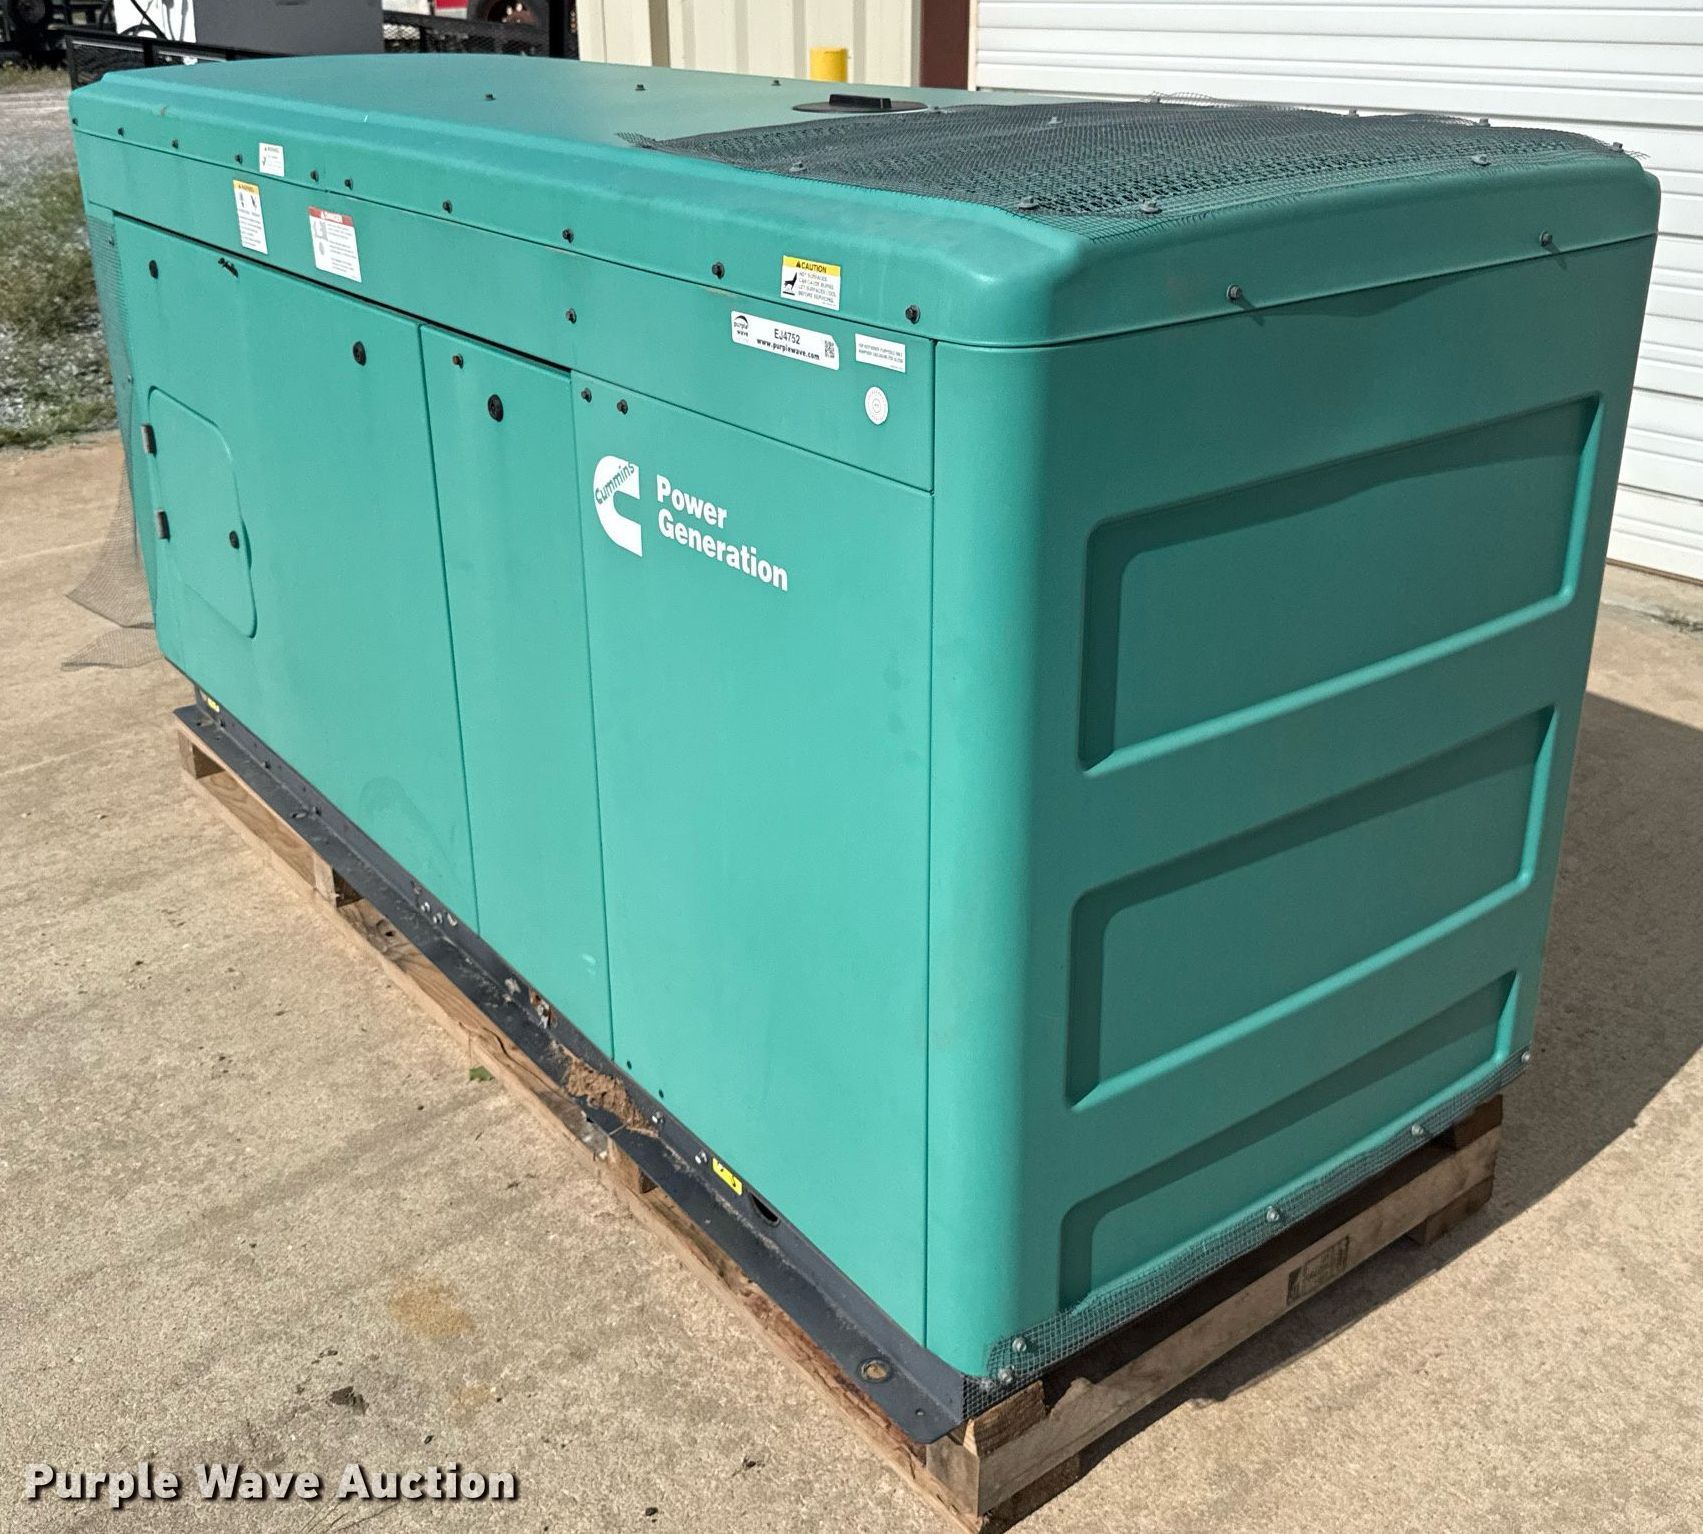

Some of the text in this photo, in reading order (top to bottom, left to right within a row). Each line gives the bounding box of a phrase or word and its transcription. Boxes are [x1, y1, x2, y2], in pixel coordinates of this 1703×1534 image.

[801, 262, 827, 273] CAUTION
[757, 338, 820, 360] www.purplewave.com
[774, 328, 801, 345] EJ4752
[594, 462, 635, 505] Cummins
[656, 474, 727, 529] Power
[658, 508, 788, 592] Generation
